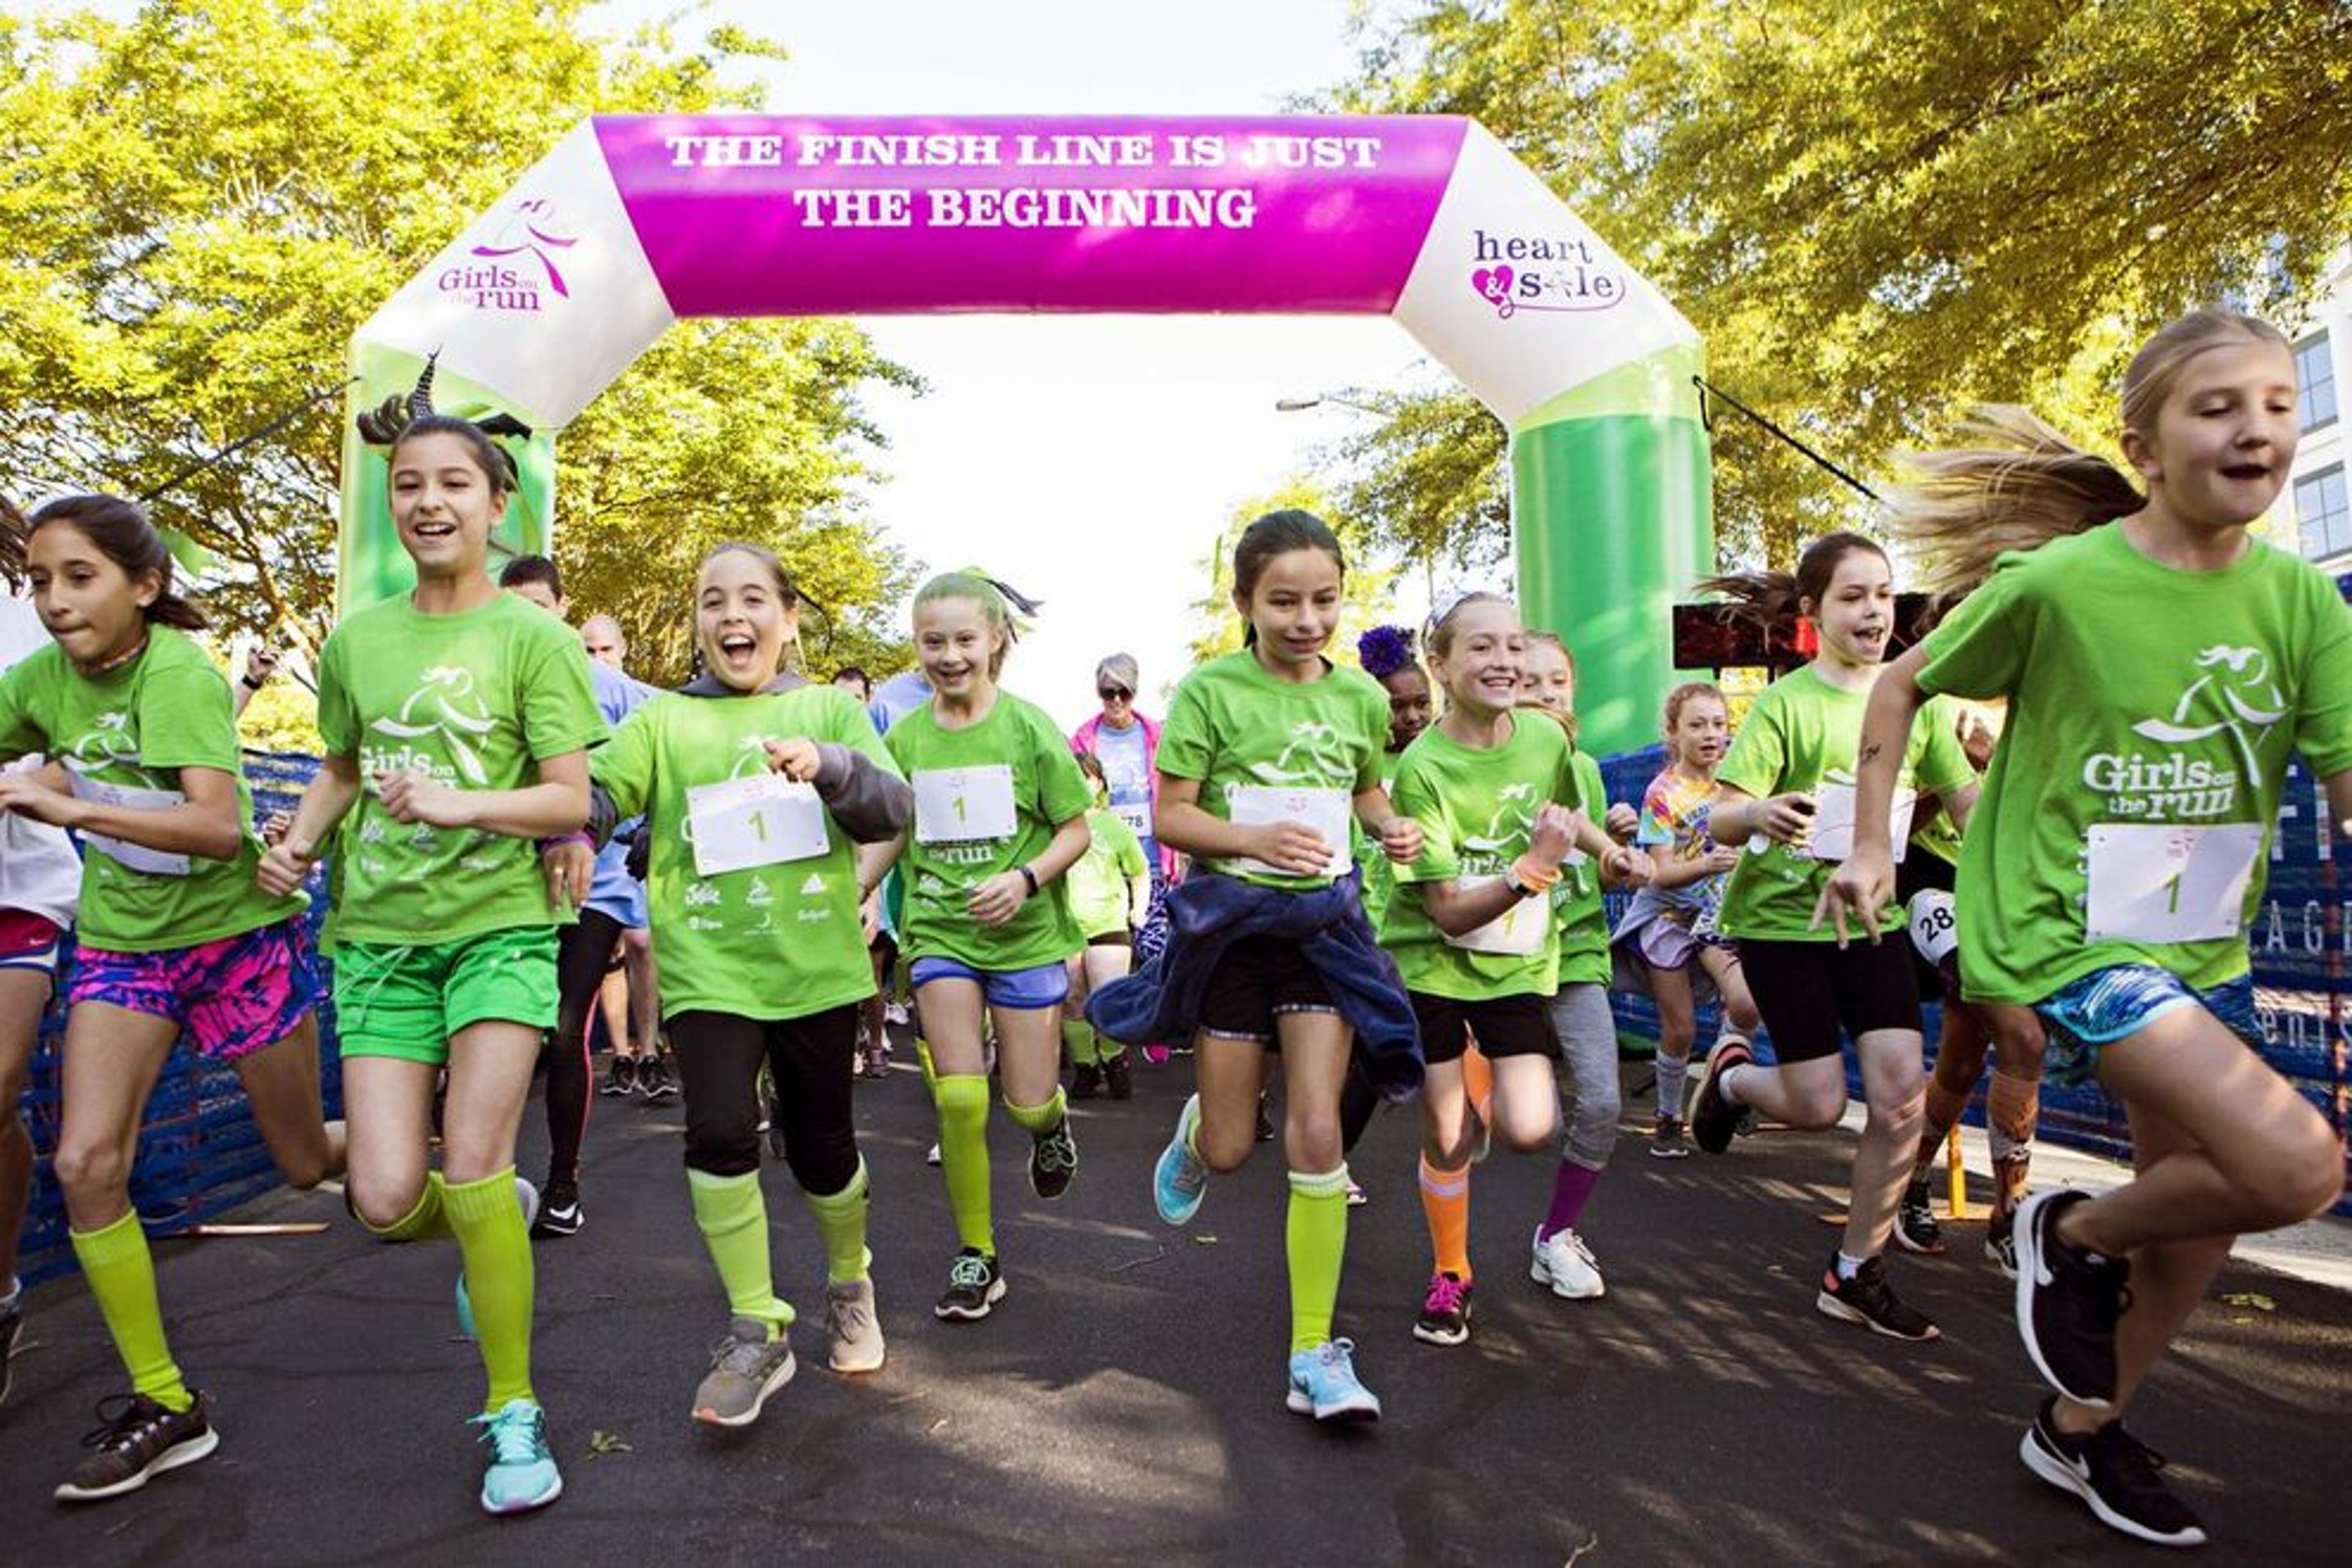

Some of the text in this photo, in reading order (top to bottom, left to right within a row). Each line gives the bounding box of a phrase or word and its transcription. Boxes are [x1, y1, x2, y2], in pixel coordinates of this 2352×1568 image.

[665, 135, 1381, 170] THE FINISH LINE IS JUST
[794, 189, 1256, 228] THE BEGINNING
[1474, 230, 1593, 263] heart
[439, 265, 517, 291] Girls
[477, 291, 541, 310] run
[2084, 752, 2213, 793] Girls
[953, 796, 966, 822] 1
[2109, 786, 2234, 819] the run
[748, 810, 767, 841] 1
[1121, 814, 1144, 828] 78
[2162, 874, 2180, 913] 1
[1919, 907, 1956, 943] 28
